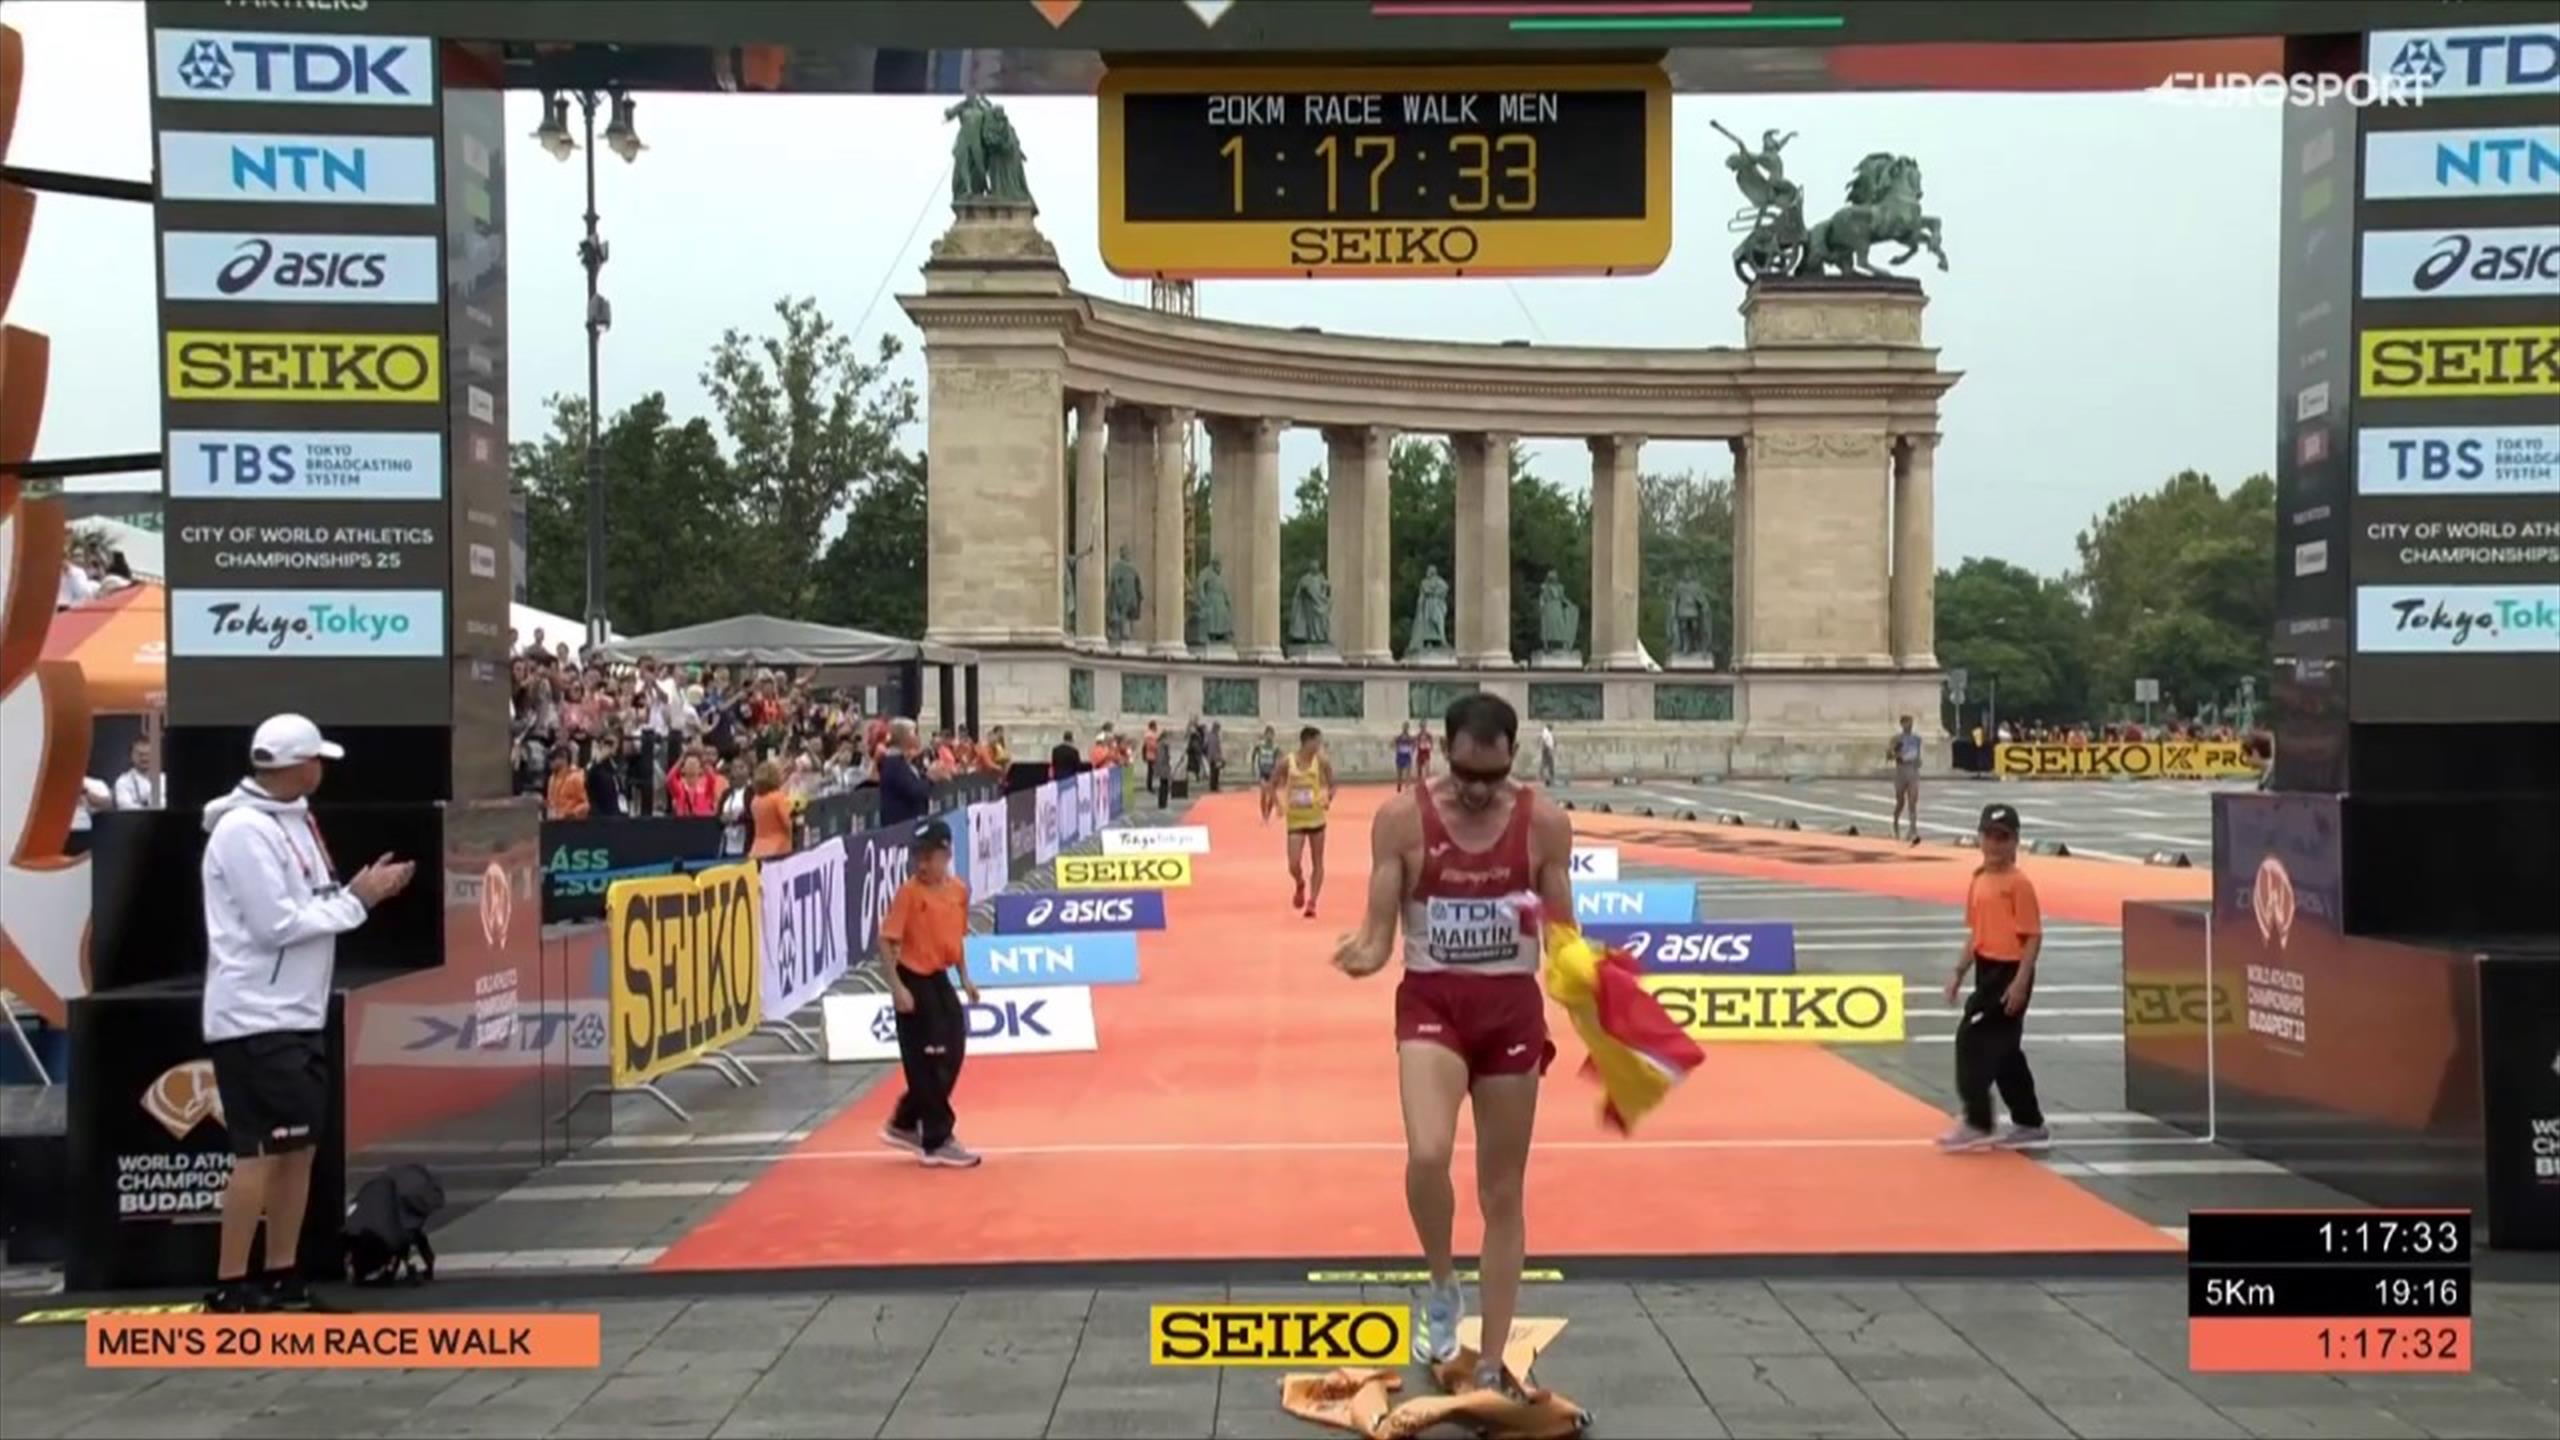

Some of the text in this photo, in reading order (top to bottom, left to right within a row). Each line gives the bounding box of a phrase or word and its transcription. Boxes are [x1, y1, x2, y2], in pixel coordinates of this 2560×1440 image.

[232, 42, 410, 95] TDK
[1207, 92, 1558, 124] 20KM RACE WALK MEN
[232, 145, 365, 192] NTN
[1220, 135, 1537, 213] 1:17:33
[1290, 227, 1477, 264] SEIKO
[275, 251, 385, 287] asics
[179, 342, 428, 391] SEIKO
[306, 445, 351, 457] TOKYO
[2496, 438, 2543, 450] TOKYO
[200, 444, 295, 485] TBS
[306, 459, 412, 472] BROADCASTING
[2388, 439, 2484, 481] TBS
[306, 475, 360, 486] SYSTEM
[2496, 469, 2552, 481] SYSTEM
[181, 527, 434, 545] CITY OF WORLD ATHLETICS
[2367, 523, 2411, 539] CITY
[2415, 523, 2442, 539] OF
[2446, 522, 2516, 539] WORLD
[215, 552, 401, 569] CHAMPIONSHIPS 25
[308, 604, 410, 641] Tokyo
[2005, 746, 2150, 774] SEIKO
[541, 845, 608, 872] ÁSS
[1065, 859, 1182, 883] SEIKO
[1060, 899, 1133, 923] asics
[1577, 892, 1644, 915] NTN
[794, 862, 835, 985] TDK
[1431, 923, 1512, 945] MARTÍN
[989, 945, 1074, 973] NTN
[1658, 933, 1752, 962] asics
[624, 875, 752, 1071] SEIKO
[963, 1001, 1051, 1039] DK
[1652, 986, 1888, 1029] SEIKO
[118, 1154, 189, 1171] WORLD
